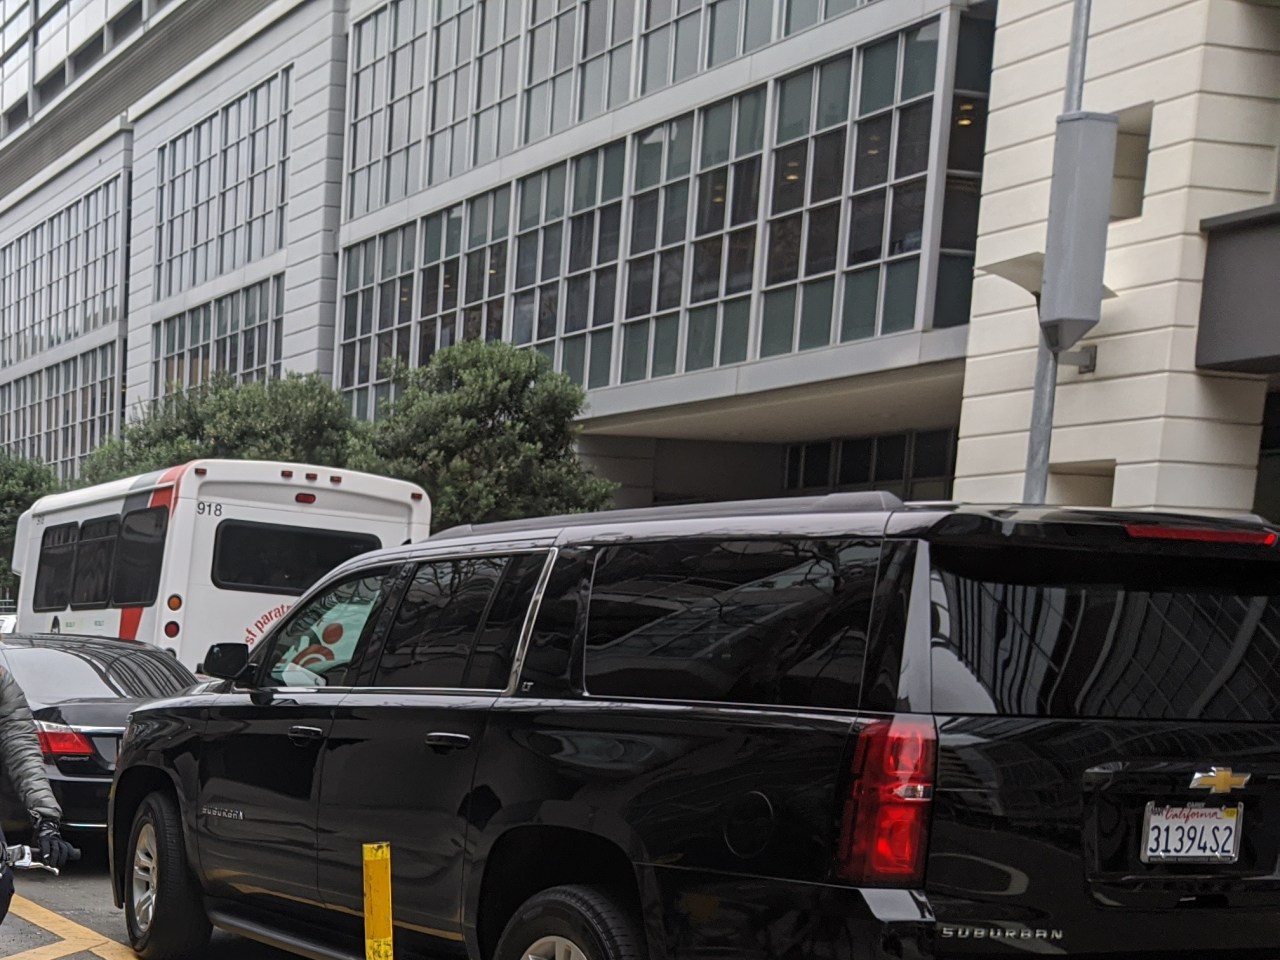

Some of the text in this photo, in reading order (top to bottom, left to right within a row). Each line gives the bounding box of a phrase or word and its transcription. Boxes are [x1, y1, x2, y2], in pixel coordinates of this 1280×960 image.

[197, 501, 222, 517] 918
[245, 627, 257, 645] sf
[1165, 807, 1223, 824] California
[1149, 825, 1233, 854] 31394S2
[941, 927, 1063, 940] SUBURBAN
